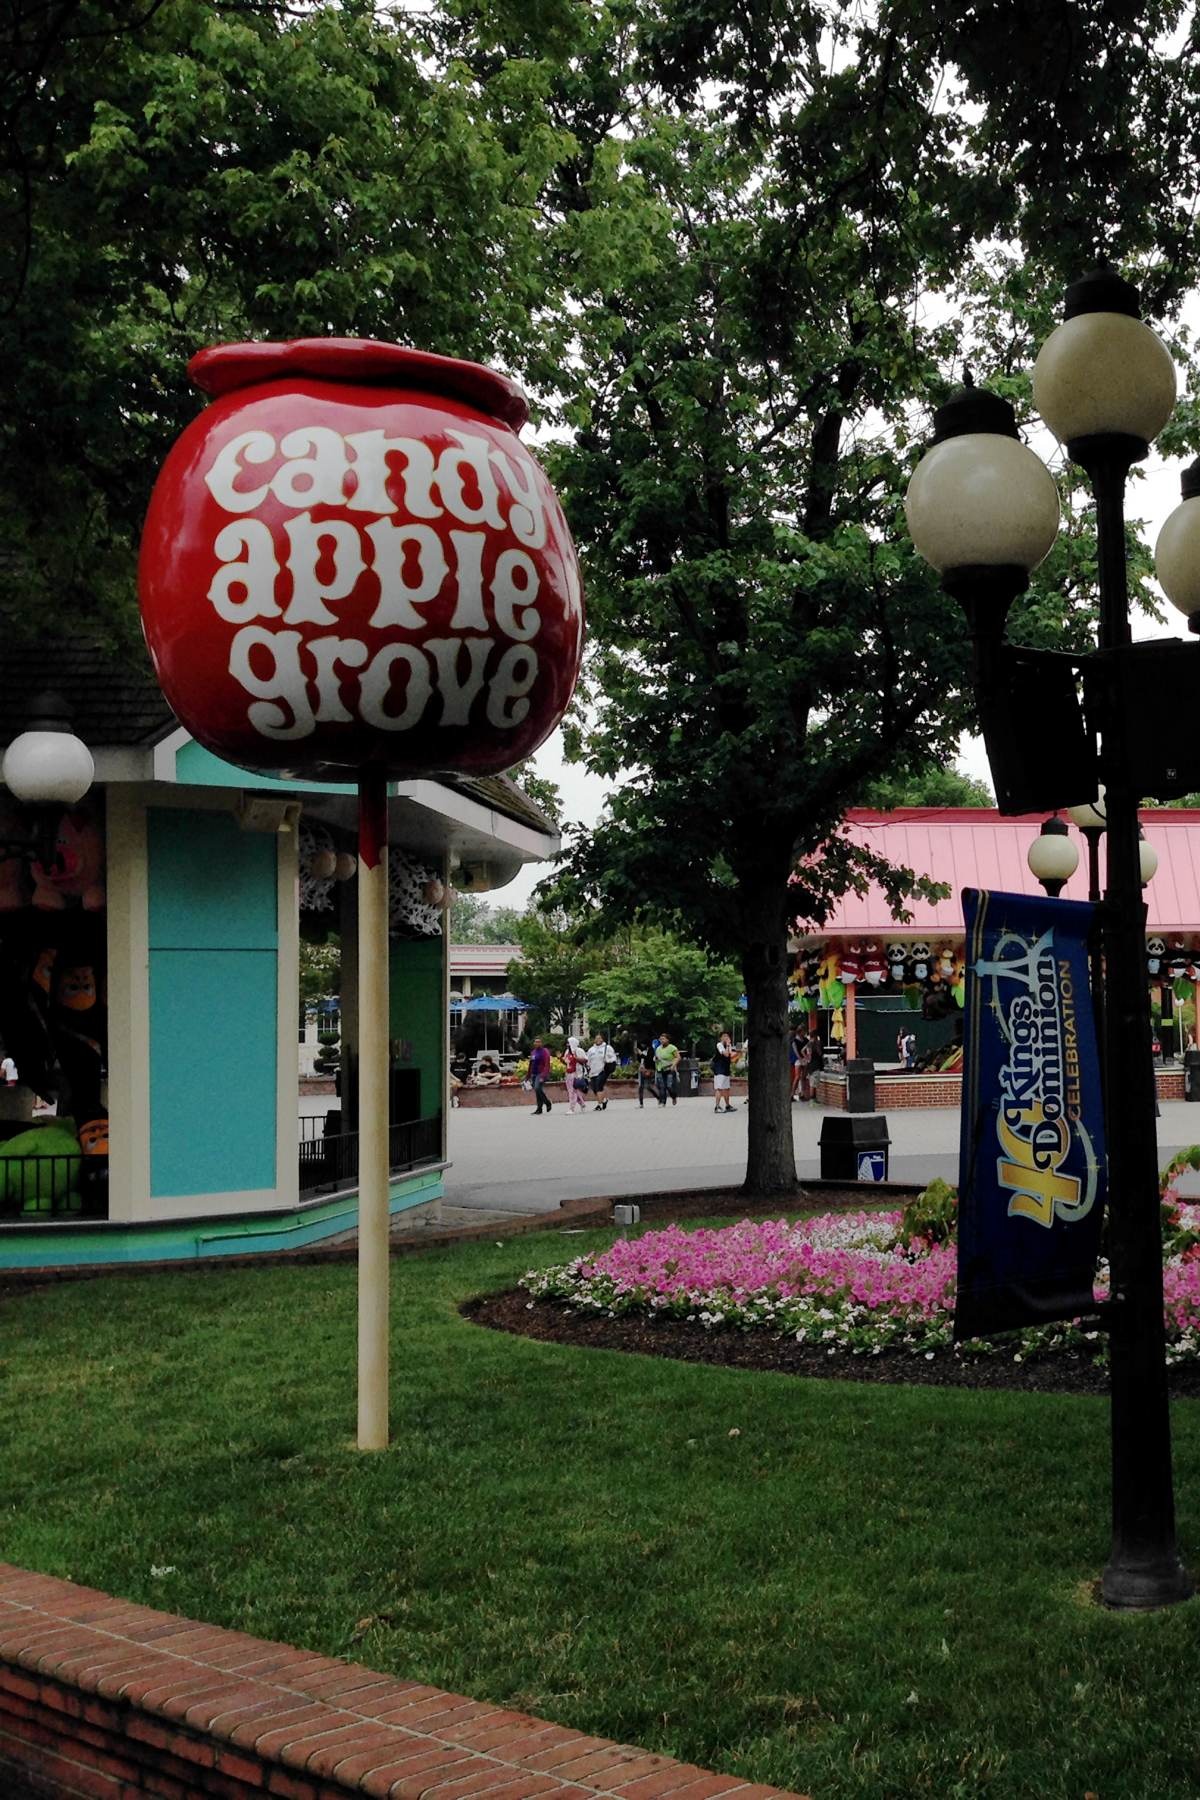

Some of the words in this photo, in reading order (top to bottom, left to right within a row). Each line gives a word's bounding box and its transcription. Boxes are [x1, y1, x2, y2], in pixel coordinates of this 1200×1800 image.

[204, 426, 547, 549] candy
[206, 511, 541, 641] apple
[229, 625, 539, 740] grove
[1001, 997, 1040, 1128] Kings
[1032, 956, 1063, 1170] Dominion
[1059, 960, 1081, 1121] CELEBRATION
